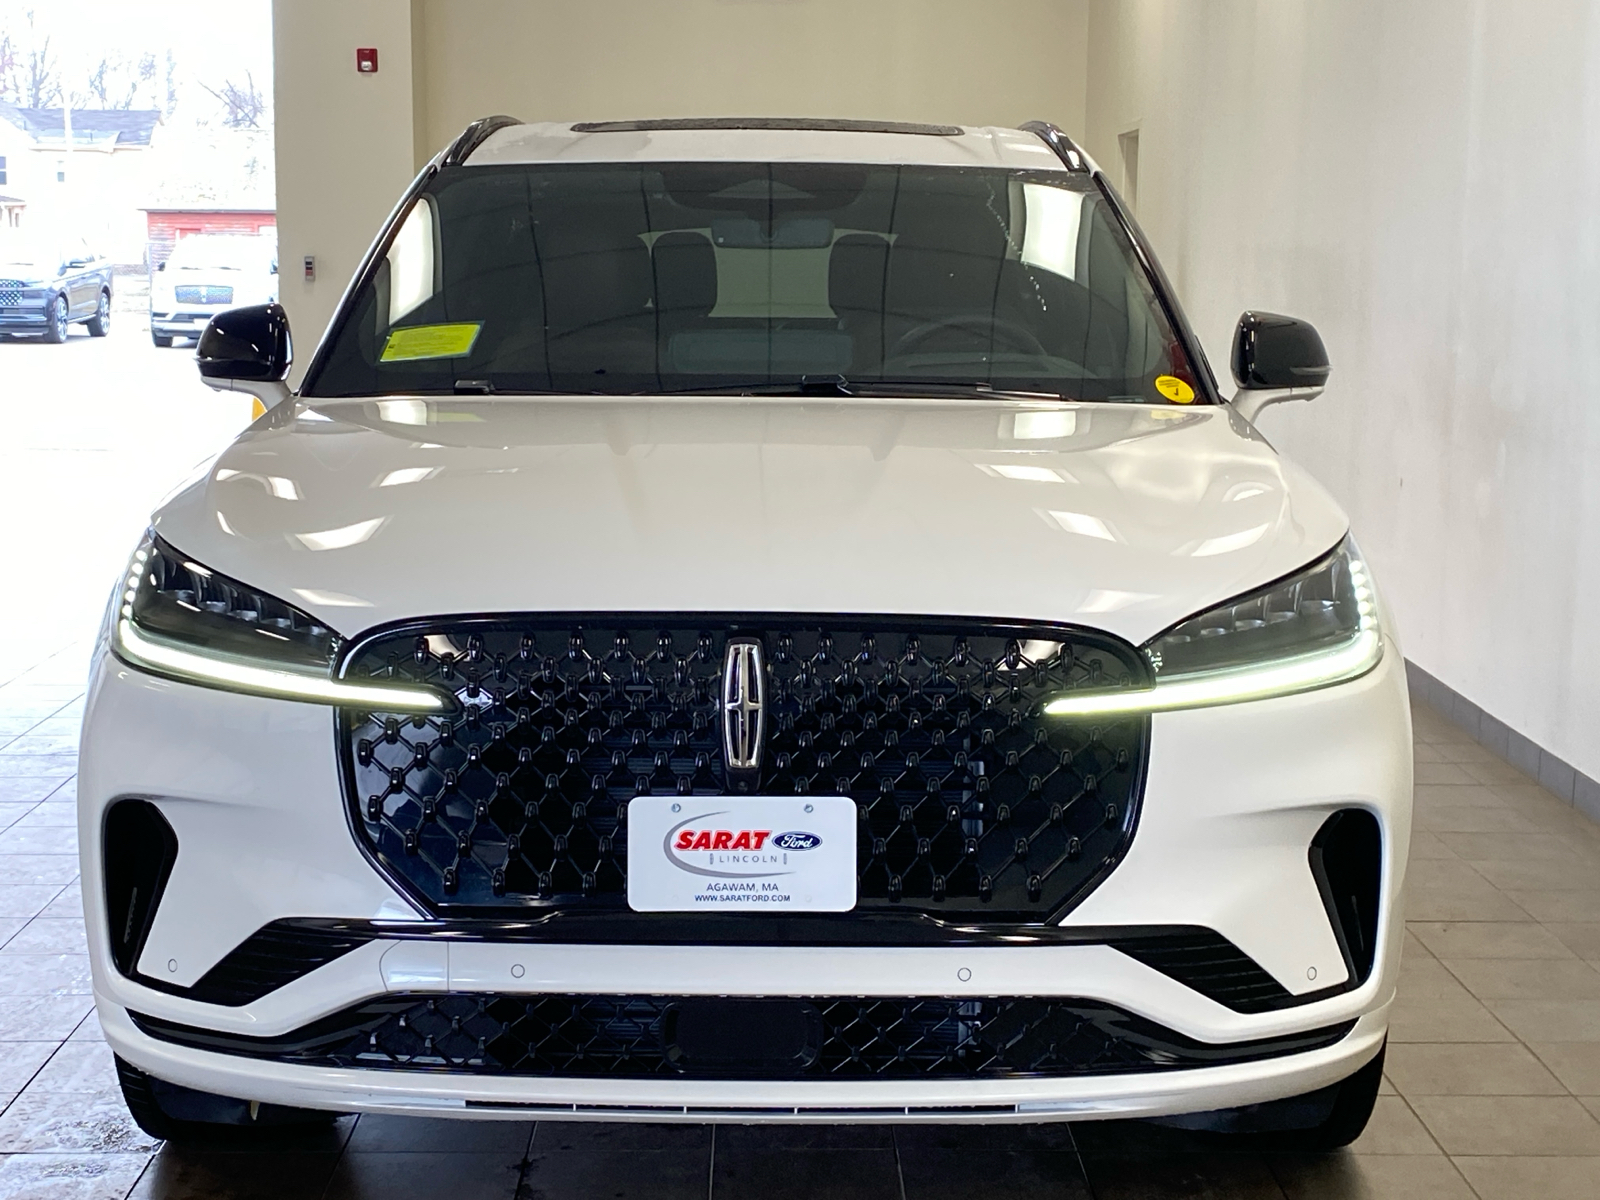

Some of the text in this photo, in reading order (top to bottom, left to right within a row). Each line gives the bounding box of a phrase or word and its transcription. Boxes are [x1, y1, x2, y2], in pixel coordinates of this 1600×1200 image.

[675, 830, 815, 851] SARAT Ford
[719, 855, 778, 863] LINCOLN
[706, 882, 779, 893] AGAWAM, MA
[694, 894, 791, 902] WWW.SARATFORD.COM
